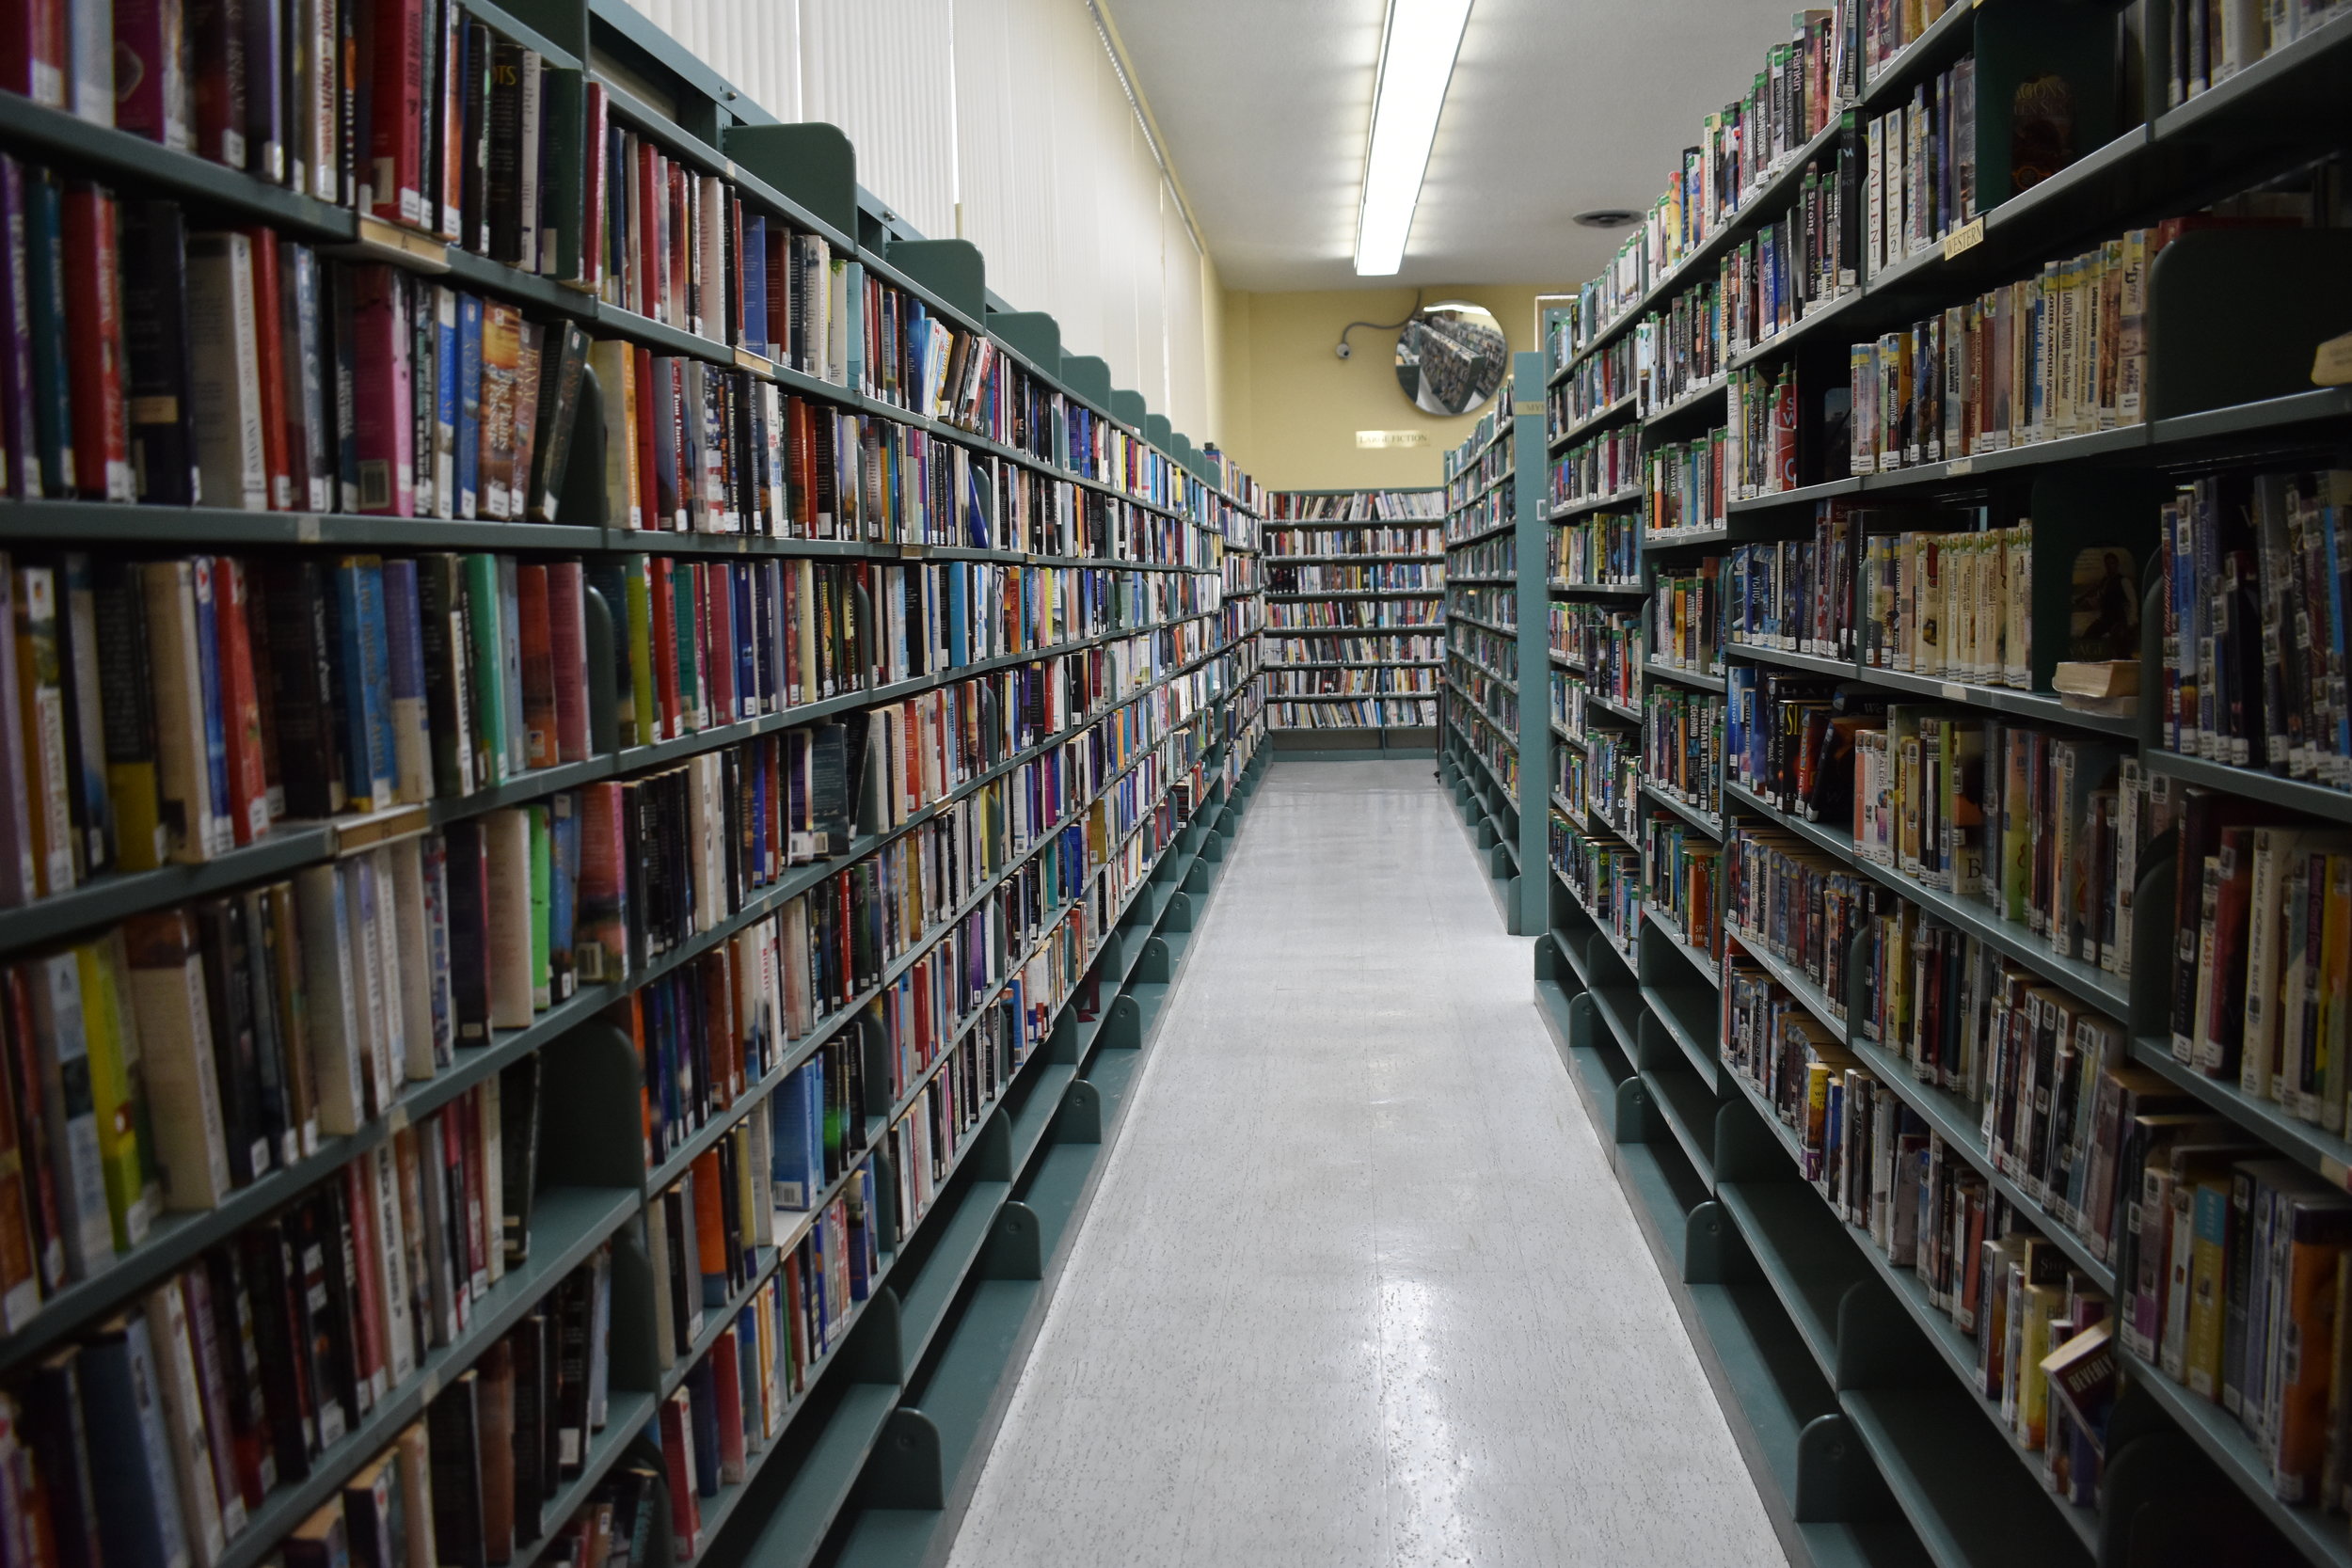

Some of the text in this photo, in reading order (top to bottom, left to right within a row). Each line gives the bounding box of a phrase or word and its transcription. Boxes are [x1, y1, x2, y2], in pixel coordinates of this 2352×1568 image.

[1792, 48, 1803, 92] Rankin
[1756, 119, 1766, 156] PATTERSON
[1869, 151, 1881, 244] FALLEN
[1888, 145, 1899, 238] FALLEN
[1805, 191, 1816, 236] Strong
[1946, 225, 1982, 256] WESTERN
[1720, 289, 1728, 332] GRISHAM
[2090, 285, 2098, 306] LOUIS
[2090, 307, 2098, 338] L'AMOUR
[2046, 326, 2056, 378] L'AMOUR
[2060, 292, 2074, 400] LOUIS L'AMOUR Trouble Shooter
[497, 371, 515, 452] The Plains
[1359, 434, 1427, 445] LARGE FICTION
[2163, 569, 2171, 632] Tomorrow
[2313, 858, 2325, 895] Behind
[2253, 905, 2264, 963] MORNING
[2312, 896, 2324, 933] Closed
[2251, 963, 2261, 993] BLUES
[2066, 1354, 2115, 1393] BEVERLY
